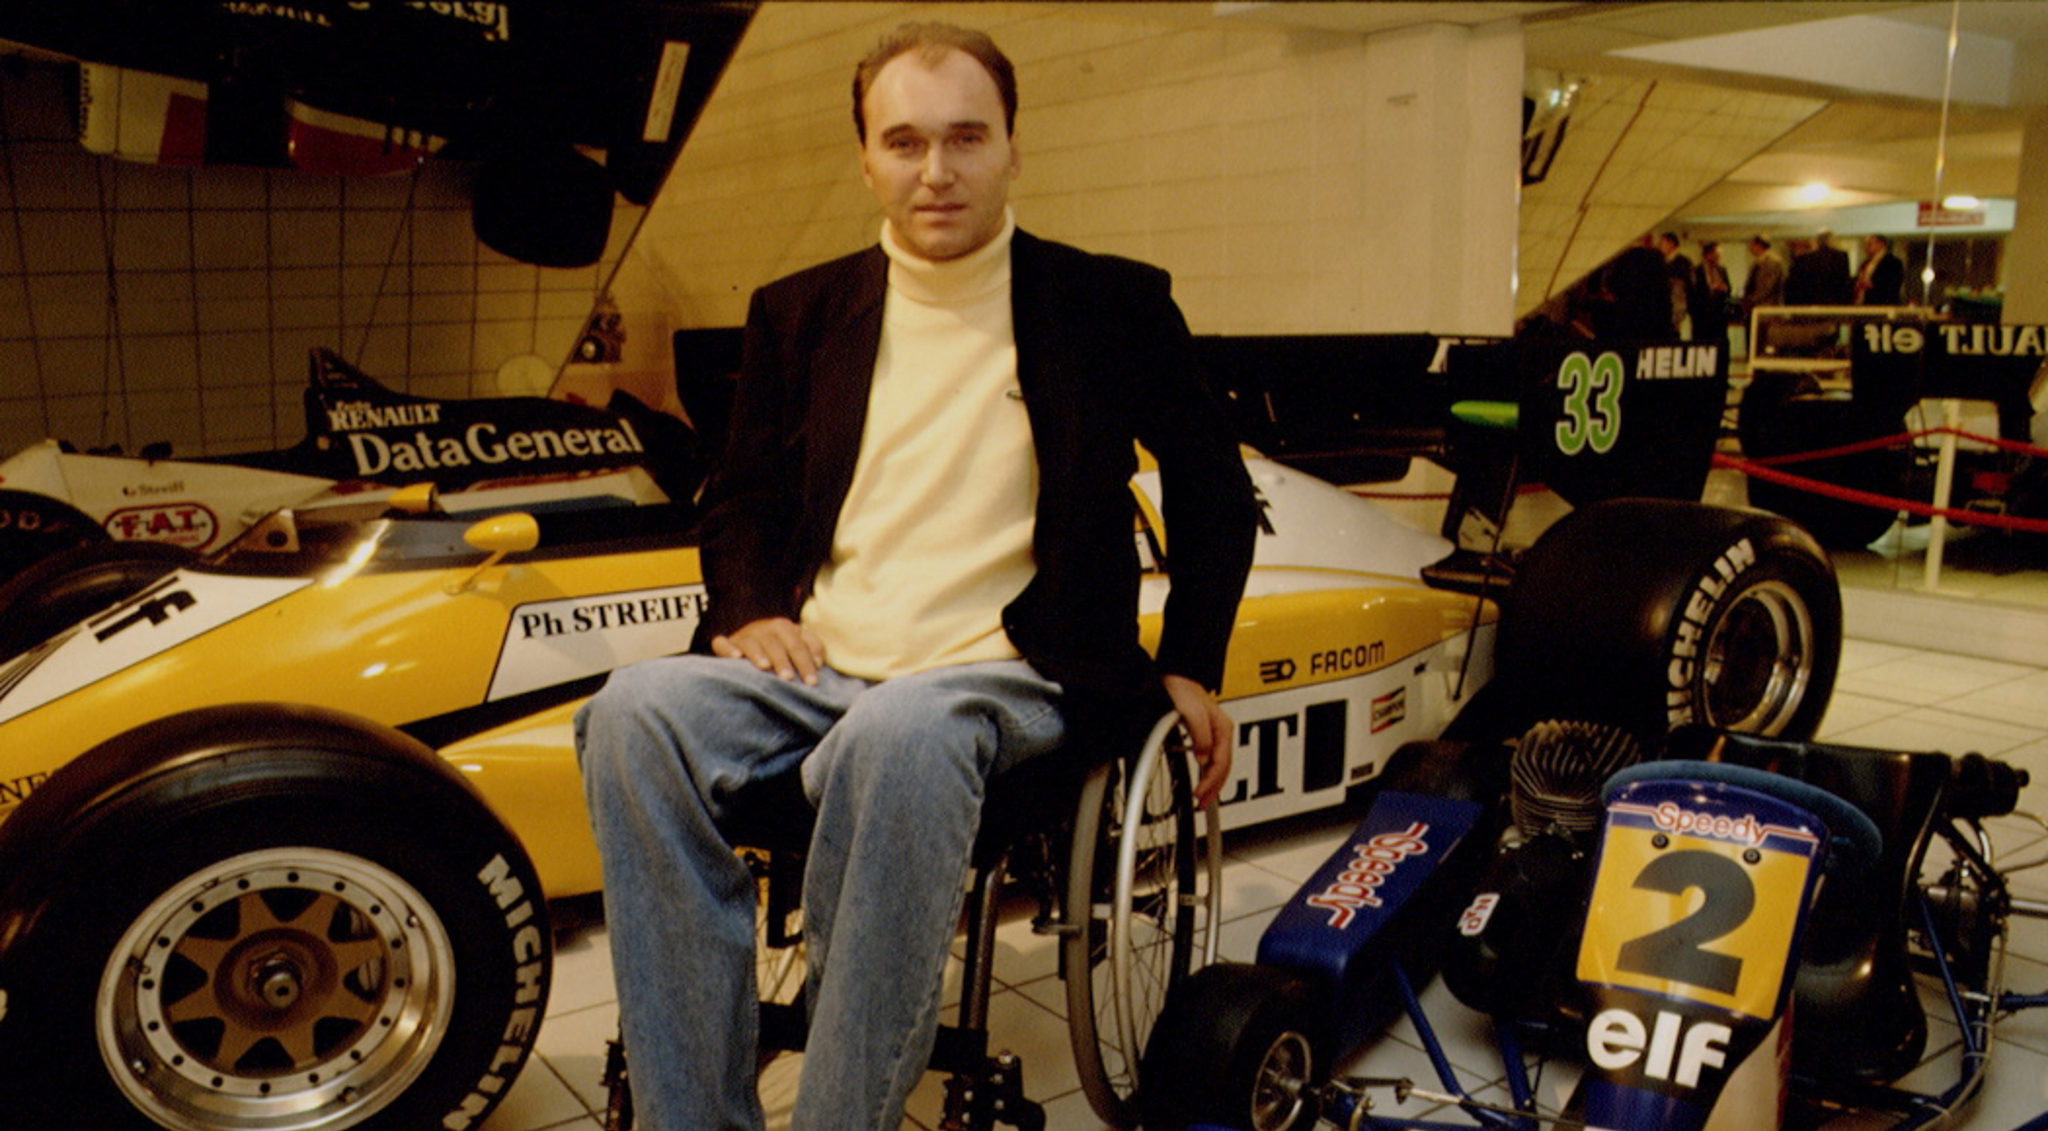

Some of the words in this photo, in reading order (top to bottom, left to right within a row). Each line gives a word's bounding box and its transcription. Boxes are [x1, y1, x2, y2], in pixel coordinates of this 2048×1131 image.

[327, 403, 440, 431] RENAULT
[1555, 352, 1625, 456] 33
[1311, 640, 1386, 676] FACOM
[1655, 802, 1768, 845] Speedy
[1307, 821, 1429, 929] Speedy
[1614, 849, 1757, 998] 2
[442, 853, 542, 1131] MICHELIN
[1587, 1008, 1732, 1089] elf
